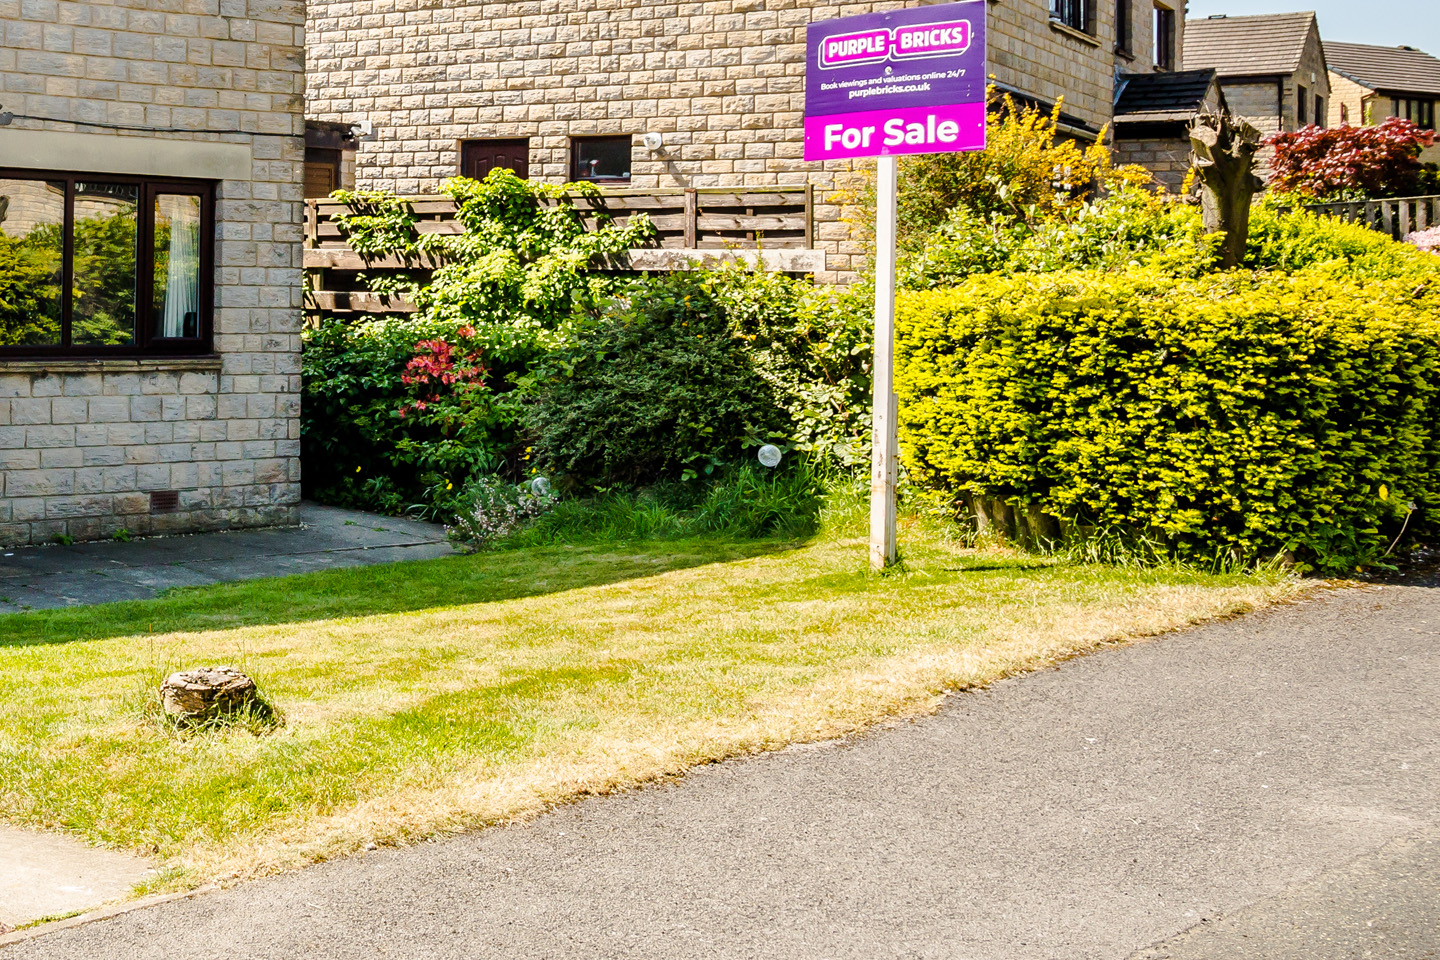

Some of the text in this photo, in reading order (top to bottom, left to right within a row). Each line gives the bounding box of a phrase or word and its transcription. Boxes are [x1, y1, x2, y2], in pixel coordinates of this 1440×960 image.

[828, 27, 963, 58] PURPLE BRICKS
[820, 82, 838, 90] Book
[838, 79, 867, 87] viewings
[882, 74, 921, 83] valuations
[921, 71, 946, 80] online
[946, 68, 966, 78] 24/7
[848, 82, 931, 99] purplebricks.co.uk
[824, 114, 959, 151] For Sale
